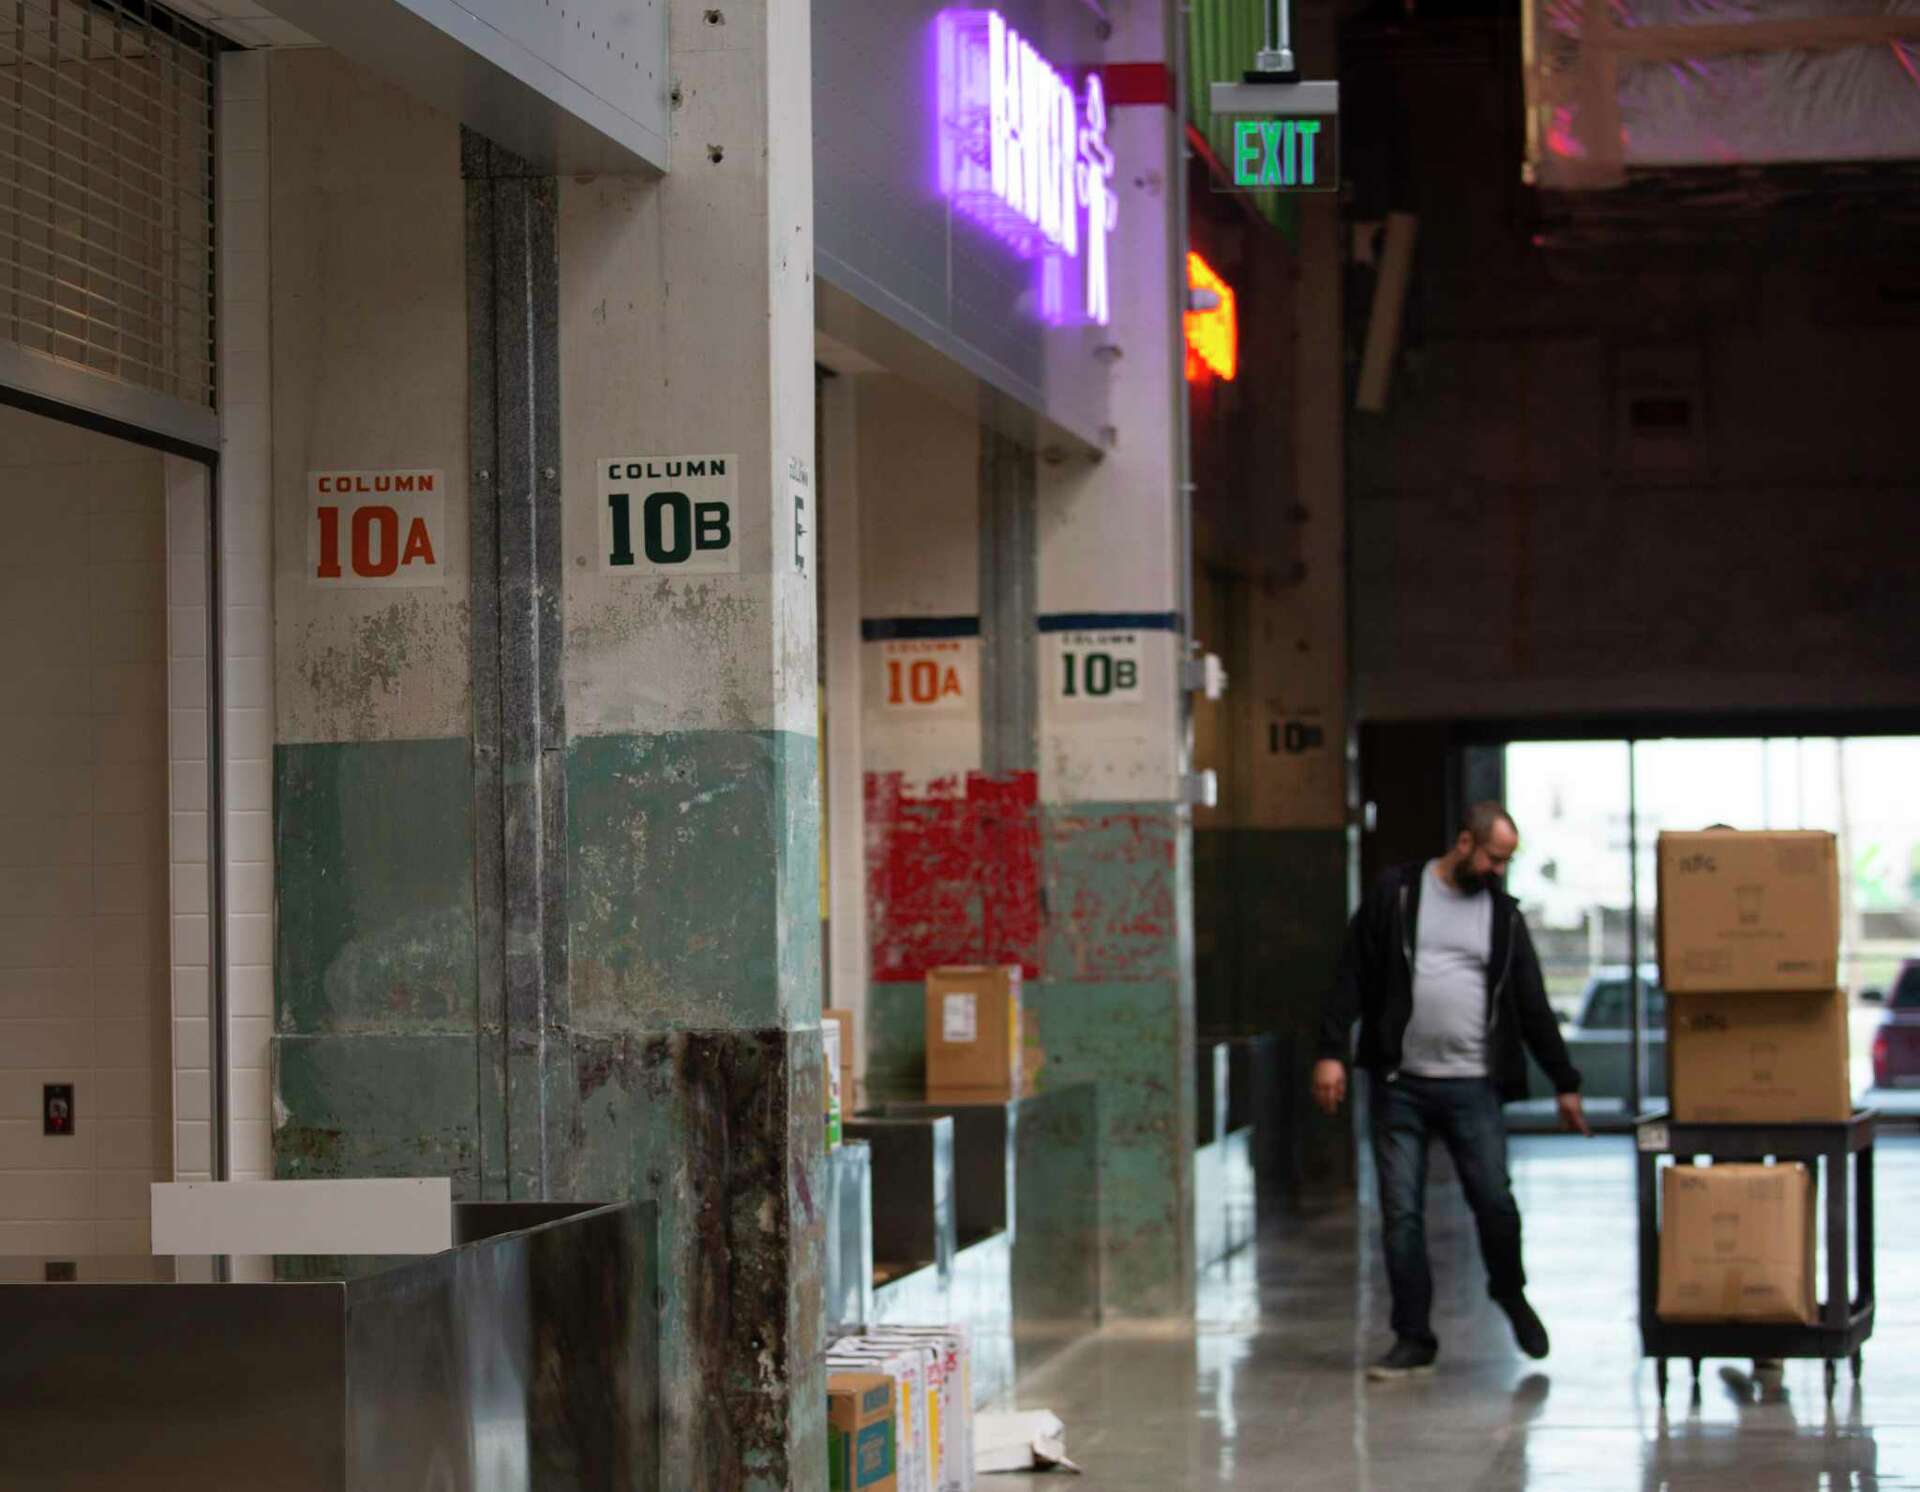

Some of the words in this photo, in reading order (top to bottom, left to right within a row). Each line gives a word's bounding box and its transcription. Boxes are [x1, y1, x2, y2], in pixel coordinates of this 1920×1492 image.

[1234, 121, 1320, 186] EXIT
[318, 475, 434, 493] COLUMN
[608, 459, 726, 480] COLUMN
[316, 505, 436, 578] 10A
[607, 491, 731, 566] 10B
[886, 659, 963, 705] 10A
[1061, 652, 1138, 697] 10B
